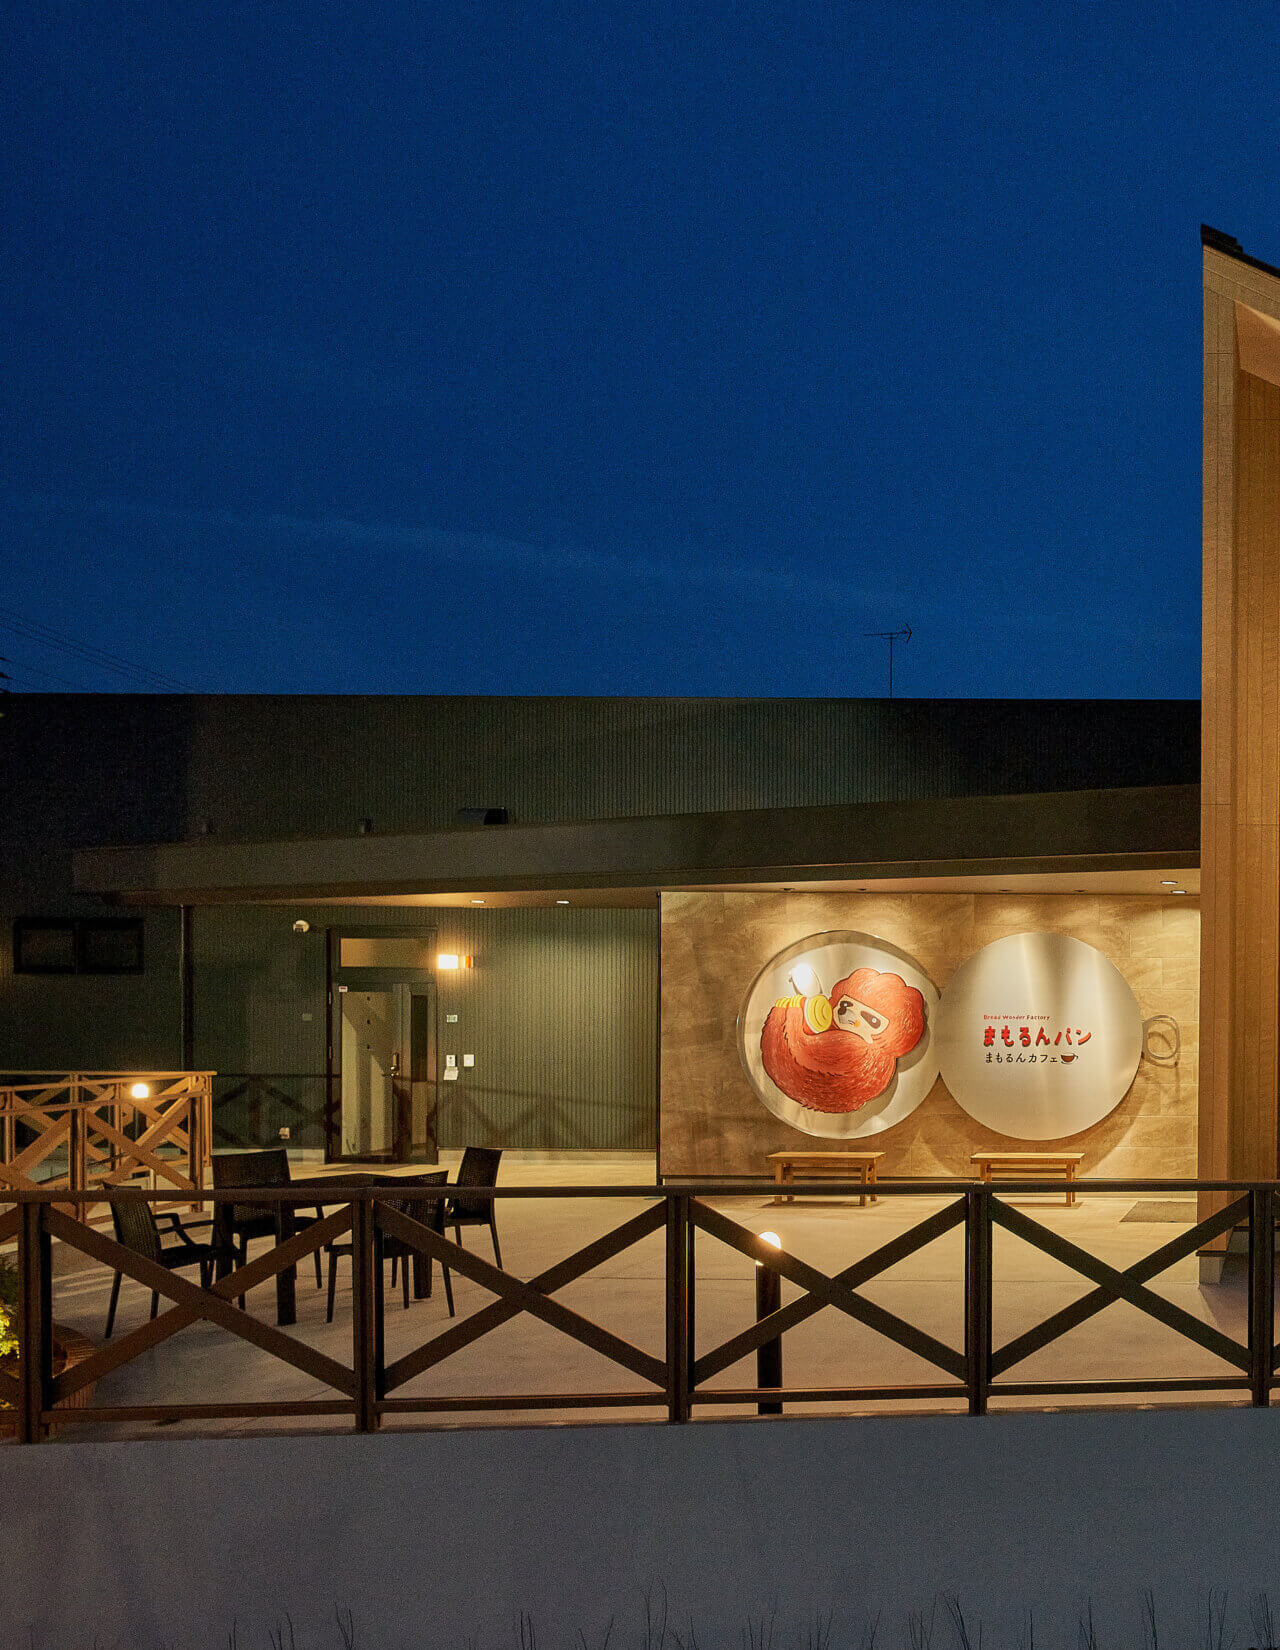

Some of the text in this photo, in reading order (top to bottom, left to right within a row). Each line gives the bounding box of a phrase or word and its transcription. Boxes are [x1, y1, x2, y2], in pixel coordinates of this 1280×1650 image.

[983, 1025, 1092, 1047] まもるんパン
[985, 1051, 1058, 1064] まもるんカフェ
